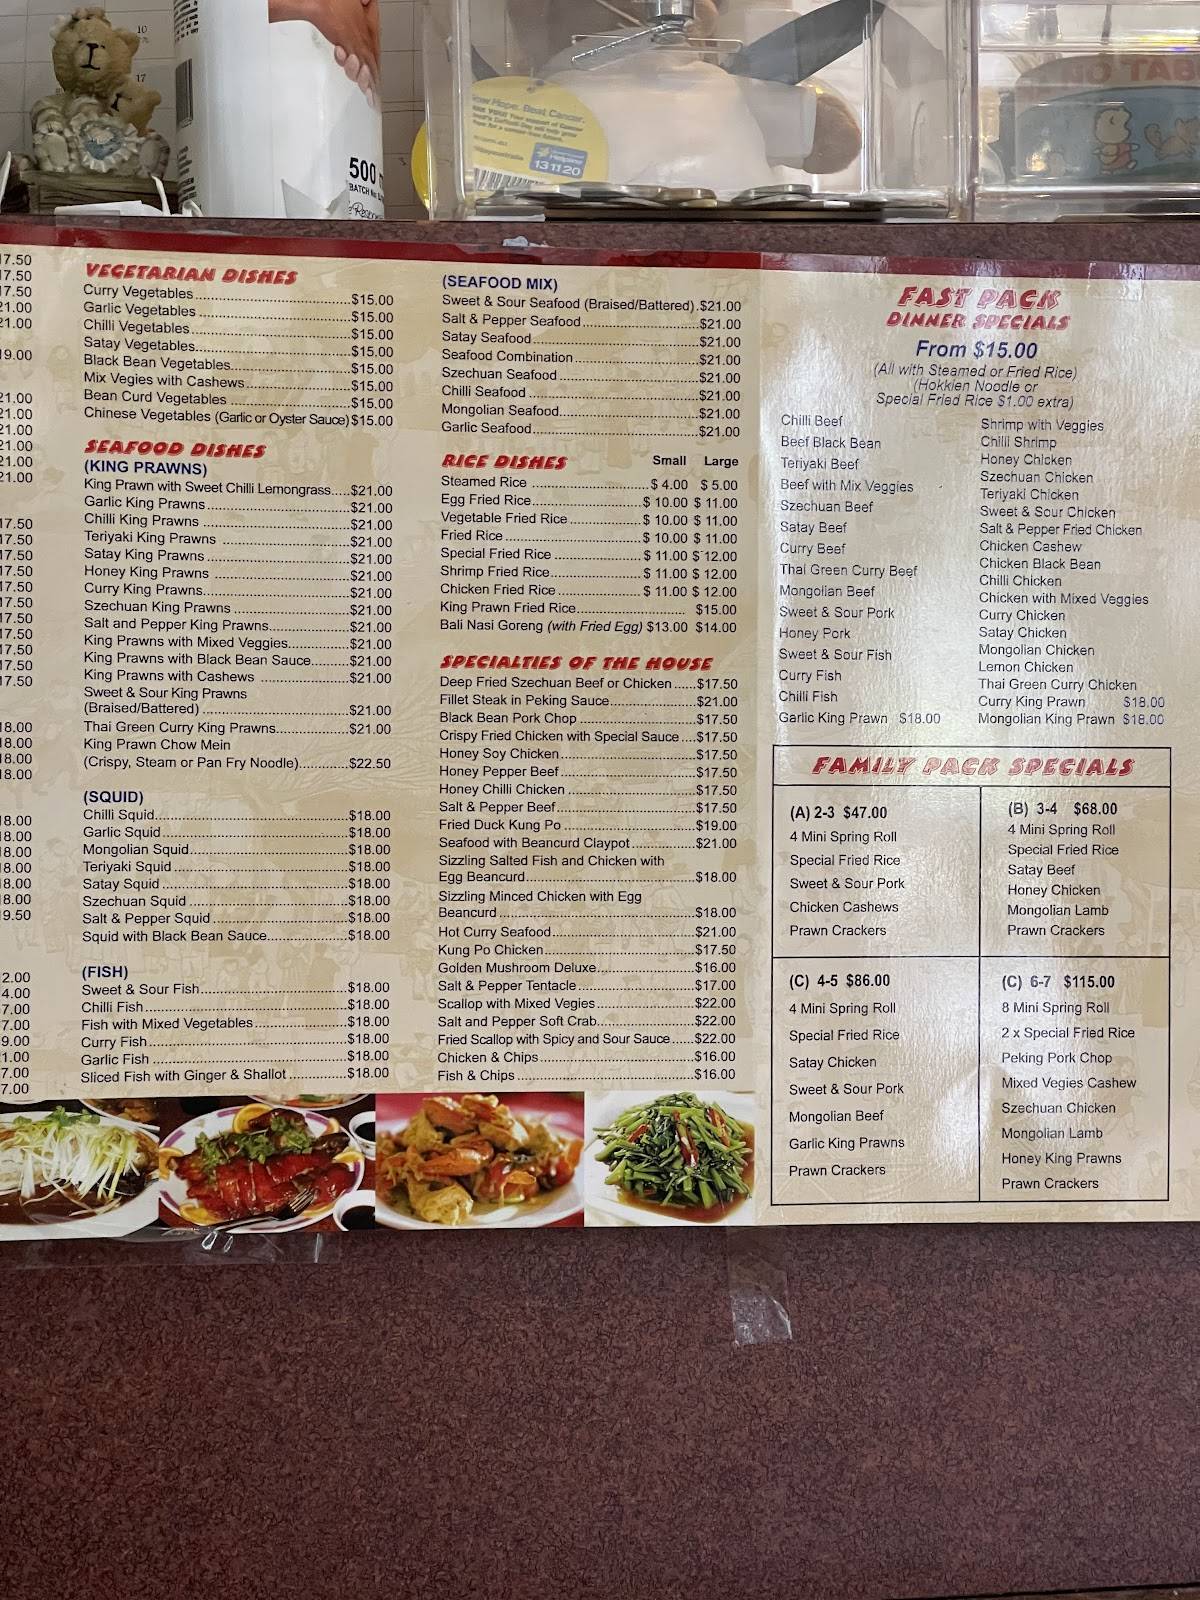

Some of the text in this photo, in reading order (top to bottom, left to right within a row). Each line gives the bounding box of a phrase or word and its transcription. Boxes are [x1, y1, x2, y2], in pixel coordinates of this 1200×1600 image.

[138, 25, 147, 33] 10
[136, 73, 145, 82] 17
[349, 157, 376, 185] 500
[534, 160, 581, 176] 13 11 20
[348, 182, 369, 196] BATCH
[86, 263, 298, 285] VEGETARIAN DISHES
[442, 274, 558, 293] (SEAFOOD MIX)
[442, 294, 742, 315] Sweet & Sour Seafood (Braised/Battered) $21.00
[898, 286, 1061, 310] FAST PACK
[887, 311, 1071, 331] DINNER SPECIALS
[916, 340, 1038, 360] From $15.00
[873, 363, 1078, 380] (All with Steamed or Fried Rice)
[914, 378, 1039, 394] (Hokkien Noodle or
[876, 393, 1074, 410] Special Fried Rice $1.00 extra)
[84, 407, 394, 428] Chinese Vegetables (Garlic or Oyster Sauce) $15.00
[981, 418, 1104, 434] Shrimp with Veggies
[84, 439, 267, 459] SEAFOOD DISHES
[84, 459, 208, 477] (KING PRAWNS)
[442, 453, 739, 470] RICE DISHES Small Large
[781, 479, 914, 495] Beef with Mix Veggies
[440, 619, 737, 635] Bali Nasi Goreng (with Fried Egg) $13.00 $14.00
[440, 655, 714, 671] SPECIALTIES OF THE HOUSE
[979, 678, 1137, 693] Thai Green Curry Chicken
[84, 687, 247, 702] Sweet & Sour King Prawns
[779, 711, 941, 727] Garlic King Prawn $18.00
[84, 738, 230, 751] King Prawn Chow Mein
[812, 756, 1135, 776] FAMILY PACK SPECIALS
[83, 790, 143, 806] (SQUID)
[790, 805, 888, 822] (A) 2-3 $47.00
[789, 831, 897, 845] 4 Mini Spring Roll
[790, 854, 901, 868] Special Fried Rice
[790, 877, 905, 889] Sweet & Sour Pork
[439, 891, 642, 905] Sizzling Minced Chicken with Egg
[789, 901, 899, 913] Chicken Cashews
[790, 925, 887, 936] Prawn Crackers
[82, 965, 129, 981] (FISH)
[1002, 974, 1115, 991] (C) 6-7 $115.00
[1002, 1002, 1110, 1016] 8 Mini Spring Roll
[1002, 1027, 1135, 1041] 2 x Special Fried Rice
[1002, 1052, 1113, 1067] Peking Pork Chop
[438, 1070, 515, 1084] Fish & Chips
[1002, 1077, 1137, 1091] Mixed Vegies Cashew
[1002, 1102, 1116, 1114] Szechuan Chicken
[1002, 1127, 1103, 1141] Mongolian Lamb
[1002, 1152, 1122, 1167] Honey King Prawns
